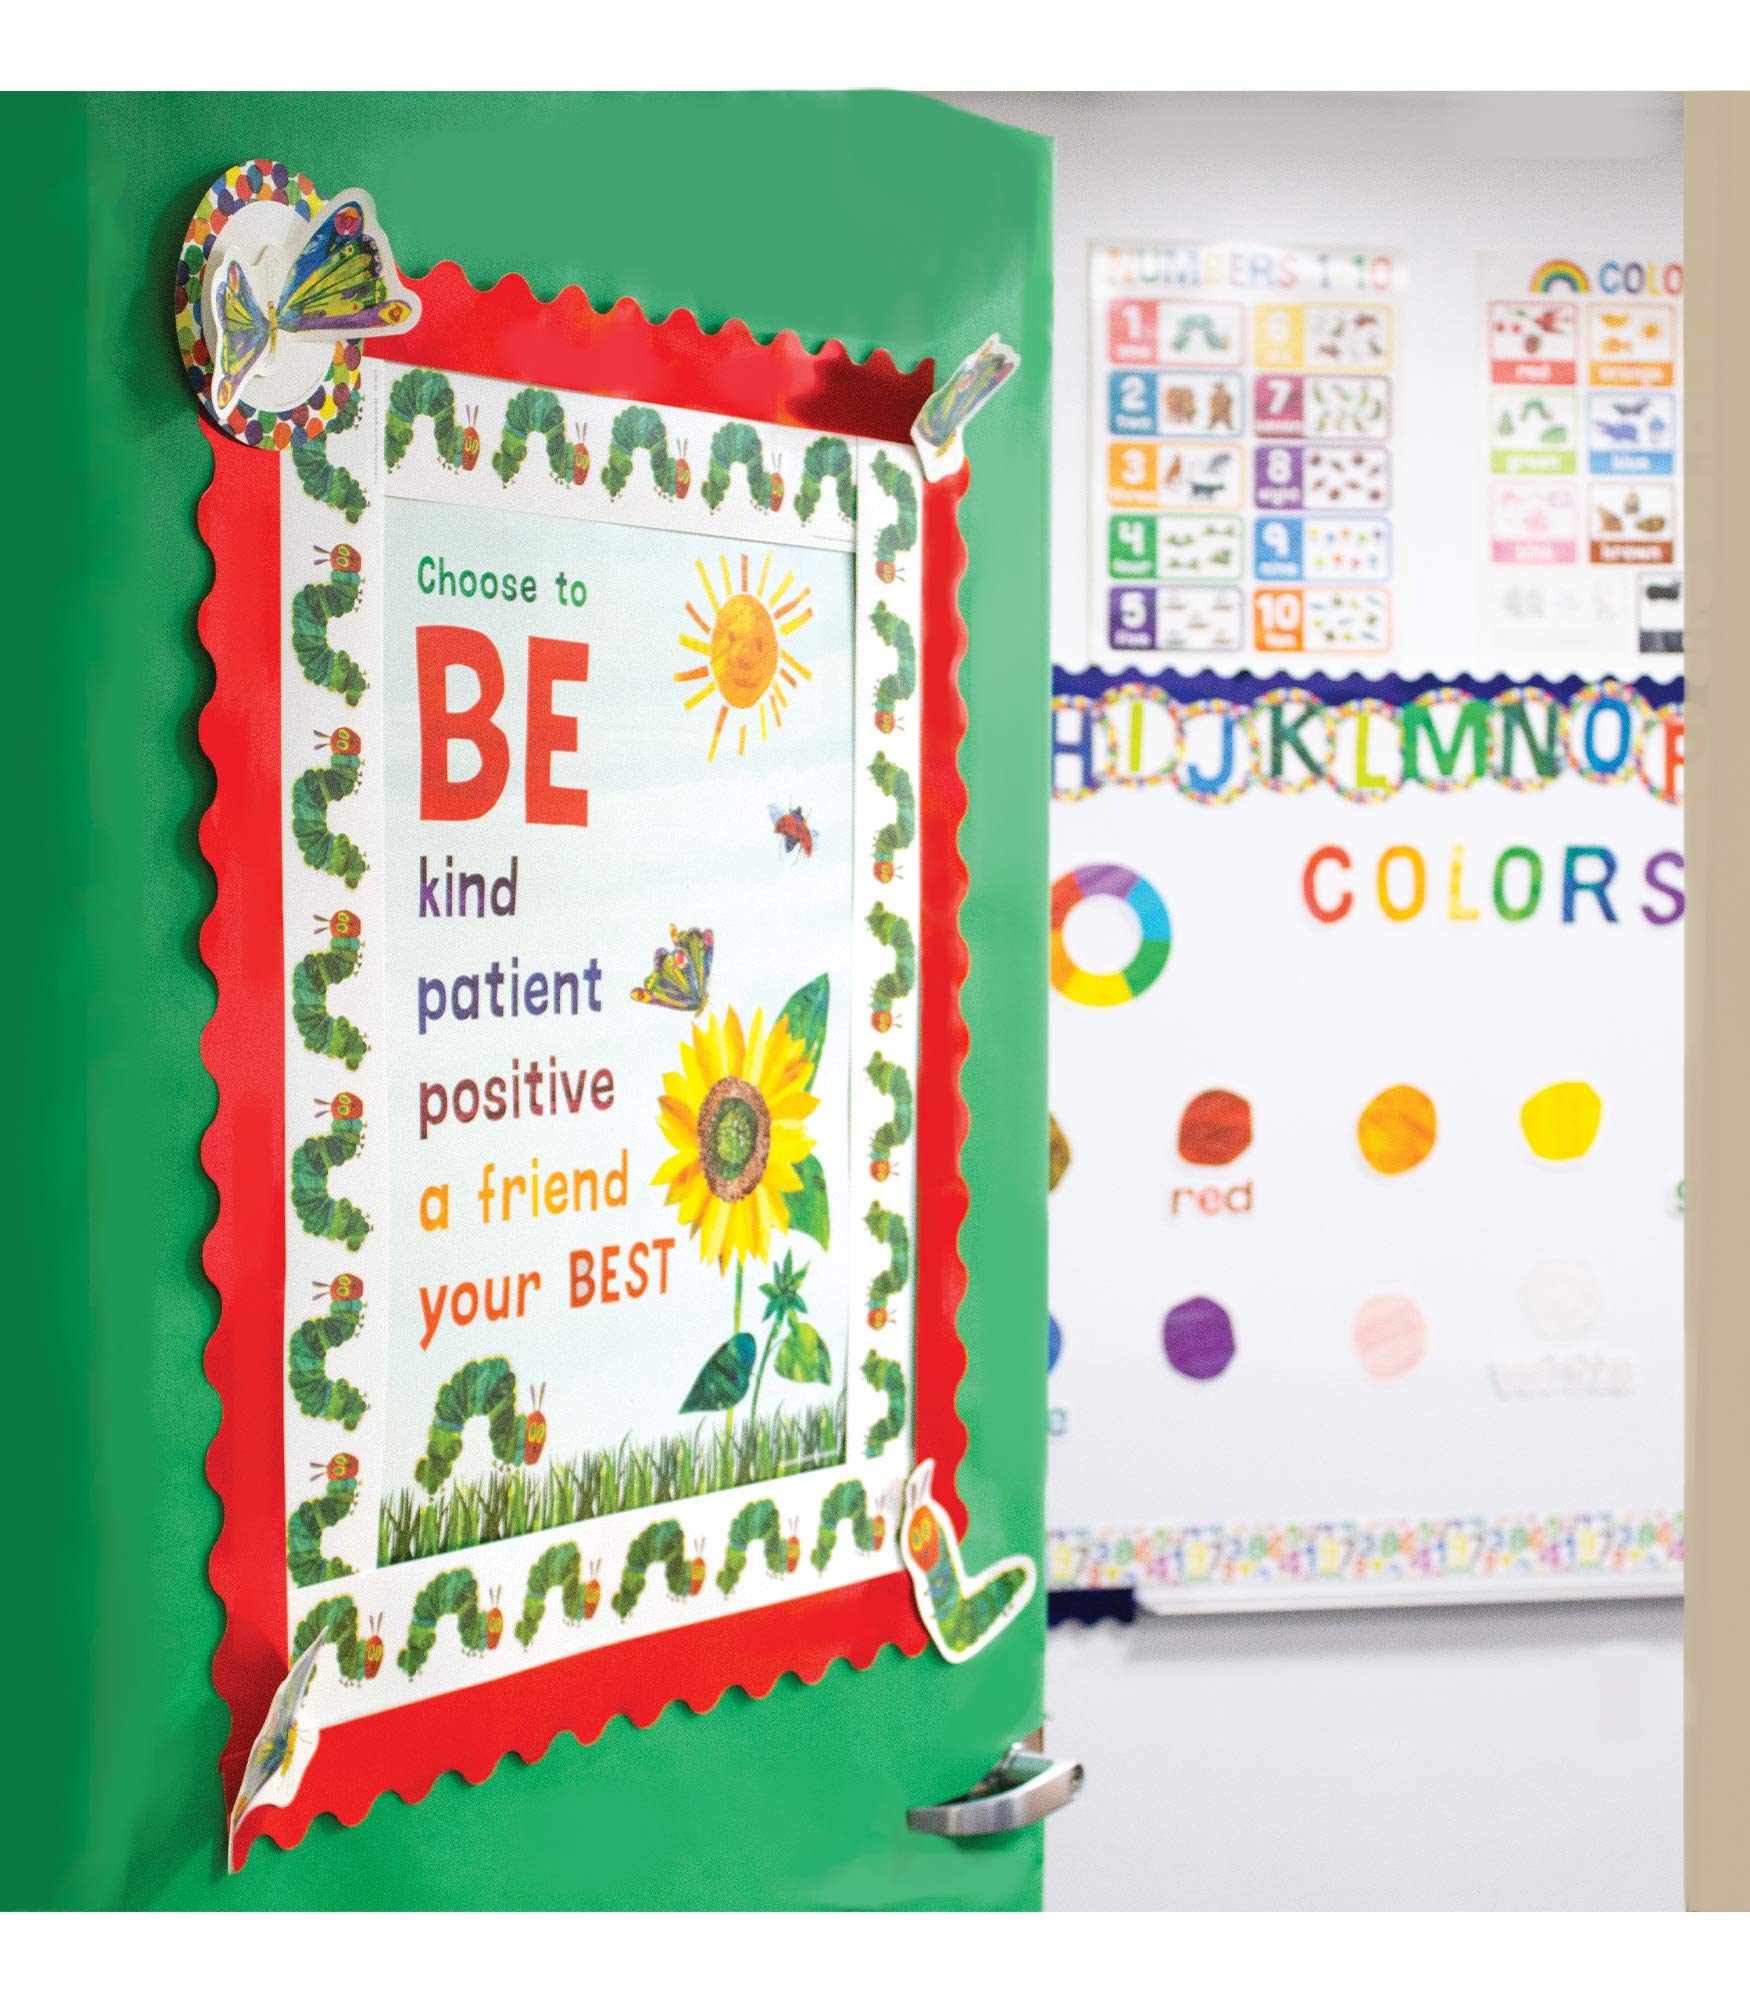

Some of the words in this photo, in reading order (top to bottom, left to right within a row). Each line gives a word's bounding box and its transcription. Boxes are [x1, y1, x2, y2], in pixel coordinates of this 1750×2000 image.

[1124, 305, 1141, 341] 1
[1120, 376, 1146, 411] 2
[1268, 379, 1292, 415] 7
[1121, 448, 1147, 485] 3
[1267, 448, 1292, 484] 8
[1118, 520, 1145, 557] 4
[1263, 521, 1290, 557] 9
[418, 555, 538, 603] Choose
[555, 571, 587, 607] to
[1120, 591, 1147, 629] 5
[1257, 593, 1300, 631] 10
[415, 624, 590, 828] BE
[418, 855, 519, 918] kind
[1301, 844, 1684, 926] COLORS
[418, 956, 602, 1035] patient
[419, 1056, 615, 1140] positive
[419, 1184, 449, 1232] a
[477, 1148, 629, 1224] friend
[1171, 1178, 1254, 1217] red
[419, 1271, 541, 1351] your
[569, 1237, 676, 1309] BEST
